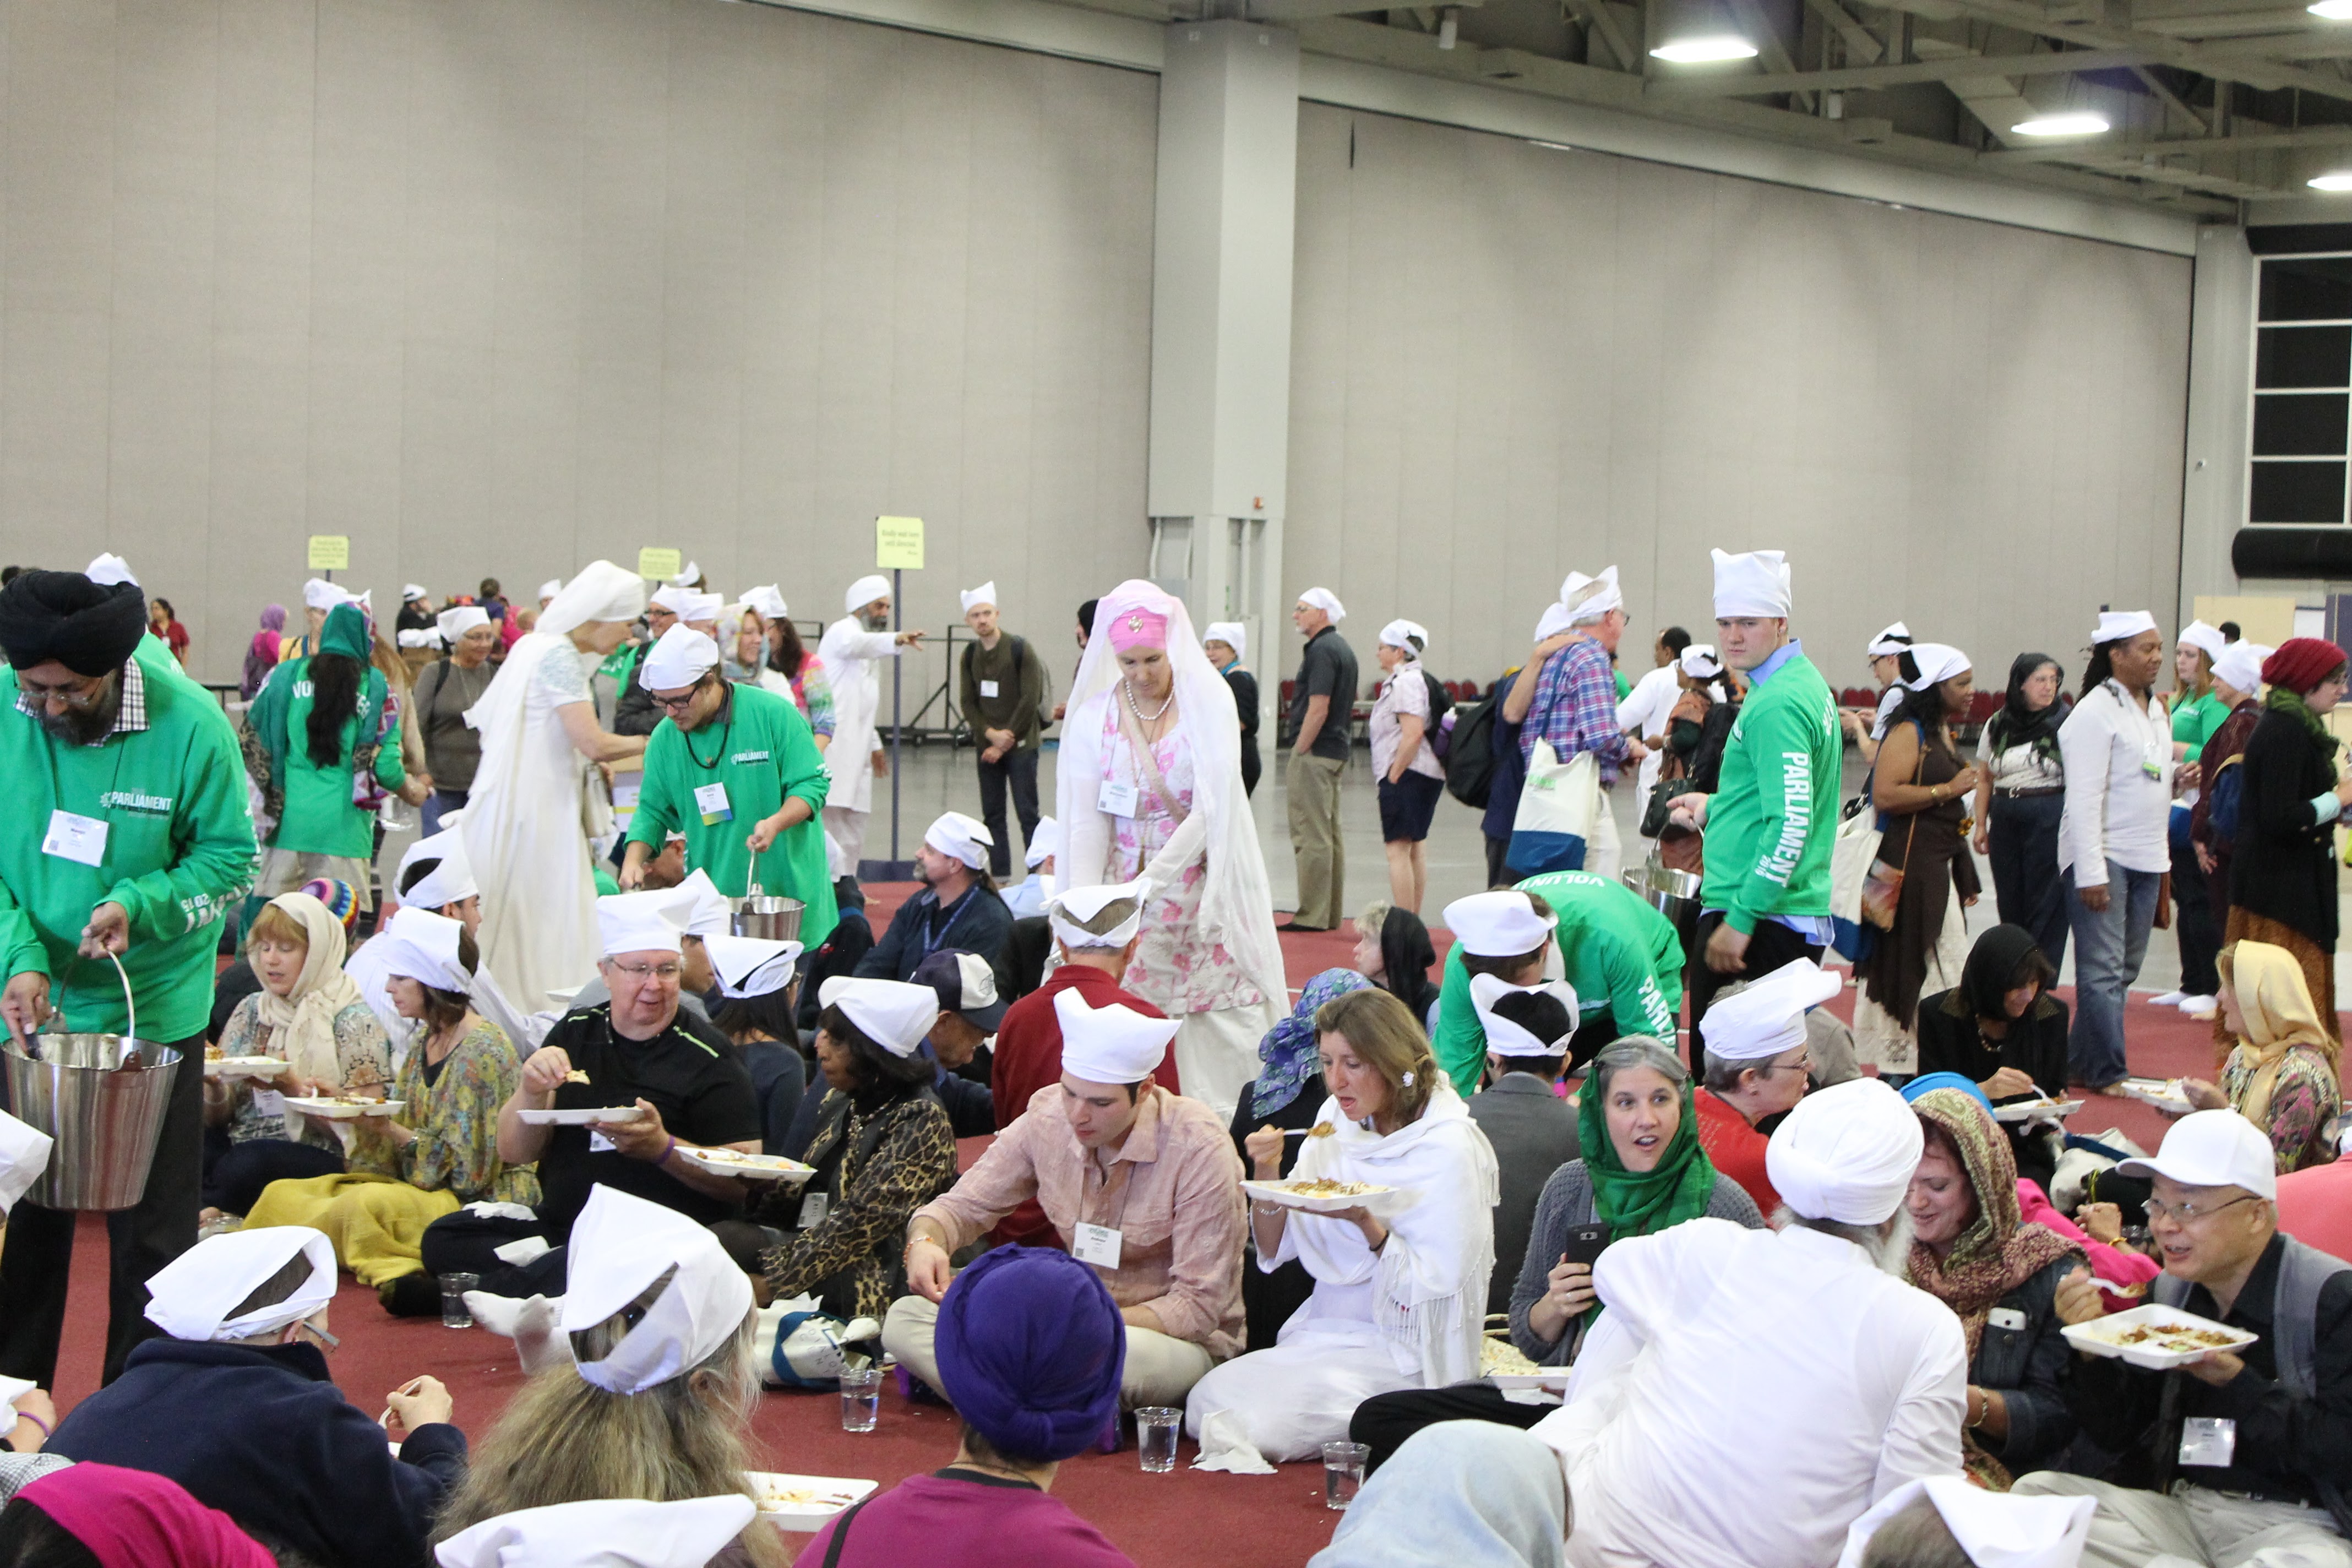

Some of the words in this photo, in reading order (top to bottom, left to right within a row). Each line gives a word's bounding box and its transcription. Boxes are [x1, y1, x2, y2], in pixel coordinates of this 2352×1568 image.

[735, 750, 769, 763] PARLIAMENT
[111, 791, 173, 811] PARLIAMENT
[1765, 752, 1810, 888] PARLIAMENT
